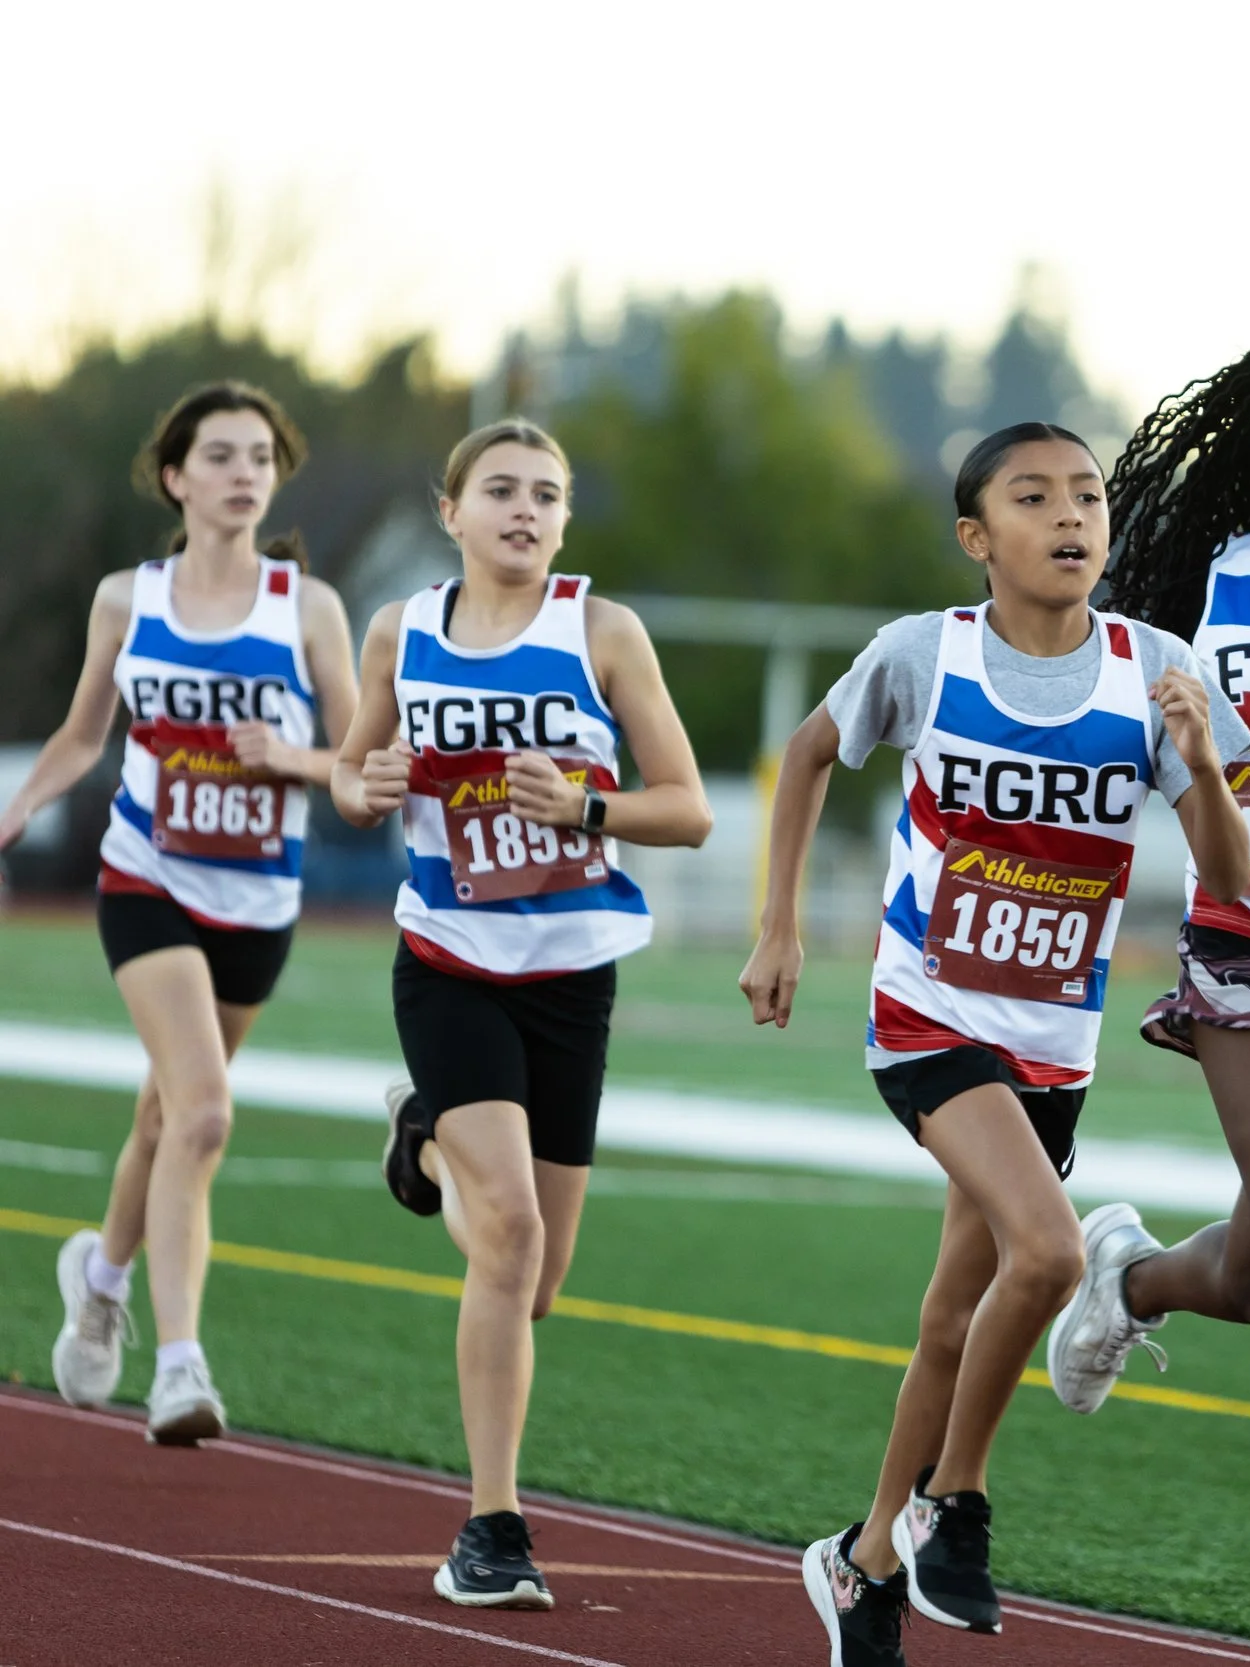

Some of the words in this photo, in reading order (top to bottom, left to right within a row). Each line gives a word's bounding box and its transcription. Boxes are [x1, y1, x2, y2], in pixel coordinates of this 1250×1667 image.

[131, 677, 286, 725] FGRC
[407, 694, 577, 753] FGRC
[167, 780, 274, 836] 1863
[939, 753, 1136, 824] FGRC
[944, 892, 1089, 971] 1859
